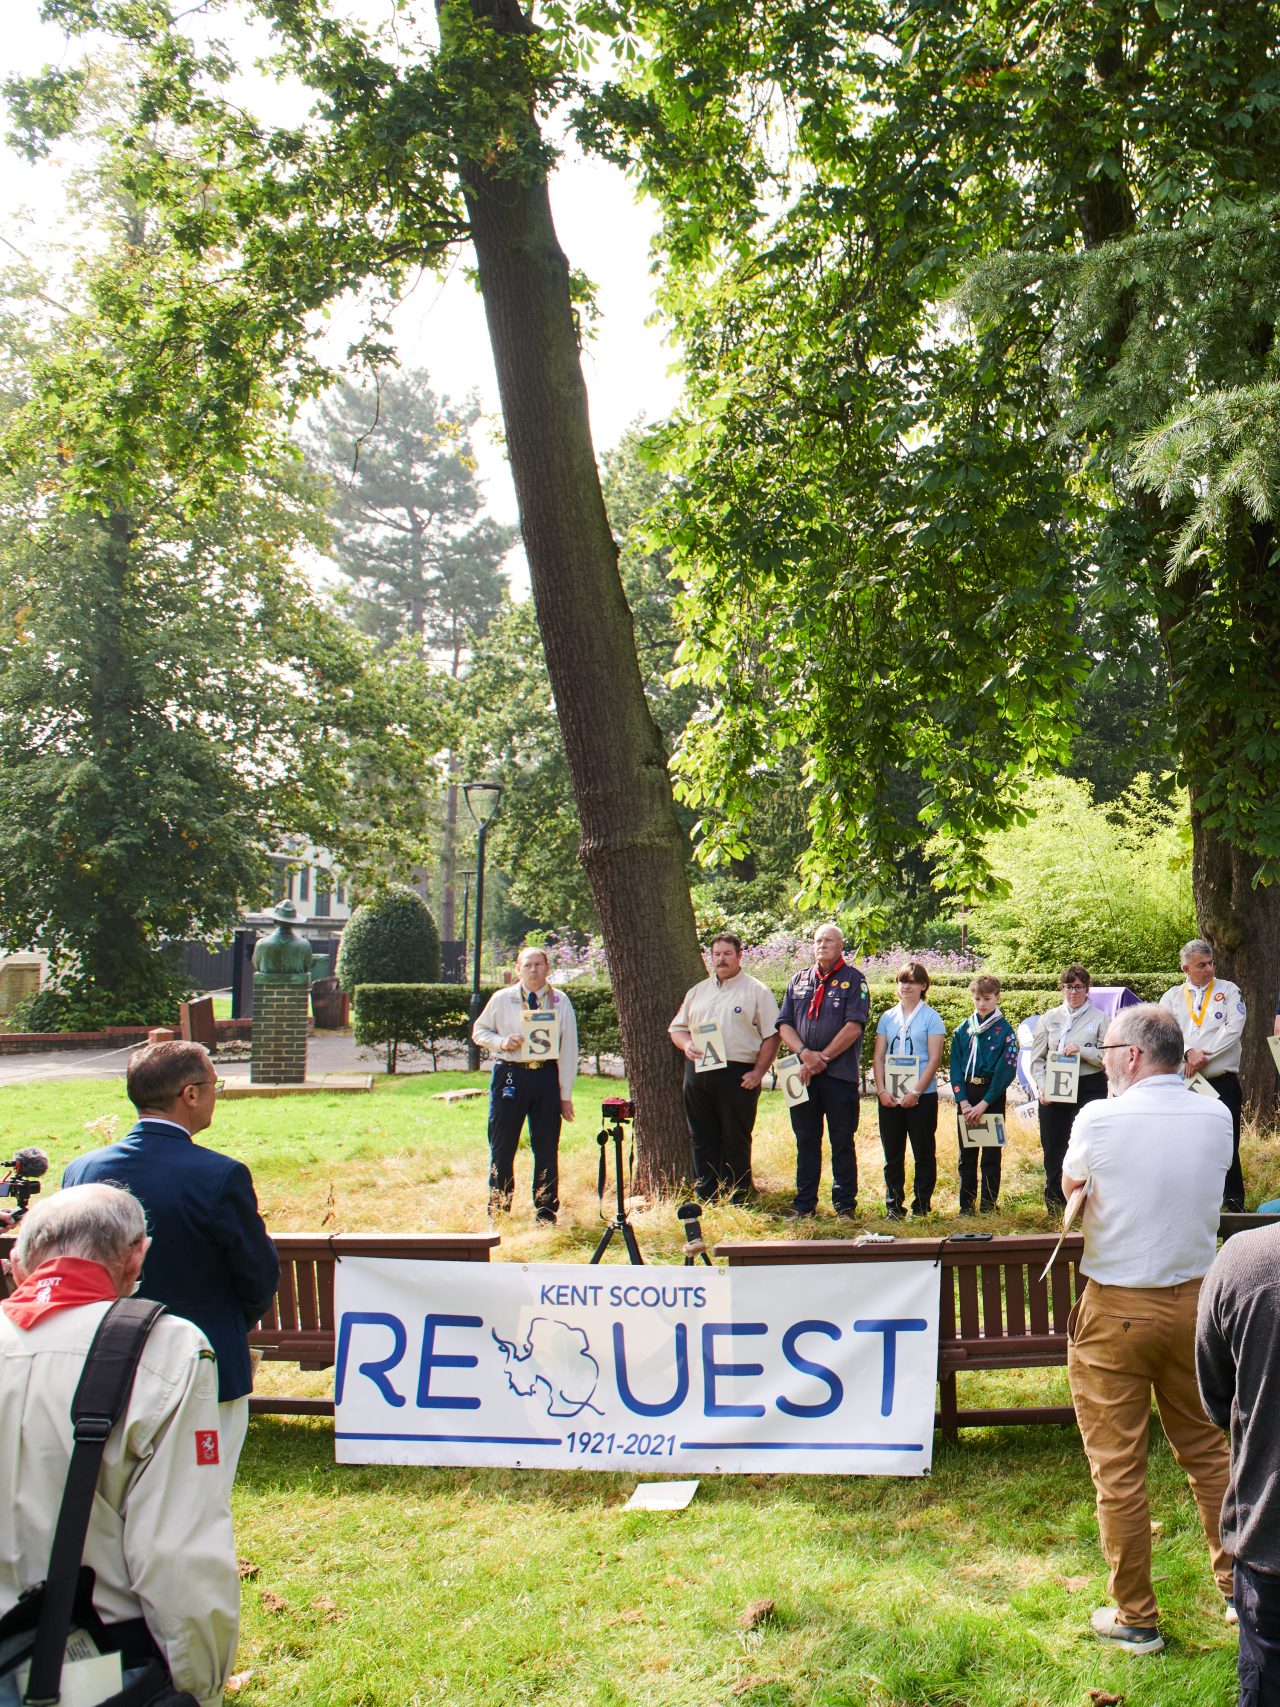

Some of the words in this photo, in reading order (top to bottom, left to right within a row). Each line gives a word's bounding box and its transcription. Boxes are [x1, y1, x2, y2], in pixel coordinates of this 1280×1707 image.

[529, 1029, 551, 1054] S
[698, 1041, 723, 1067] A
[786, 1074, 804, 1099] C
[889, 1073, 915, 1099] K
[1050, 1071, 1073, 1097] E
[541, 1285, 603, 1307] KENT
[610, 1286, 706, 1308] SCOUTS
[567, 1432, 677, 1456] 1921-2021
